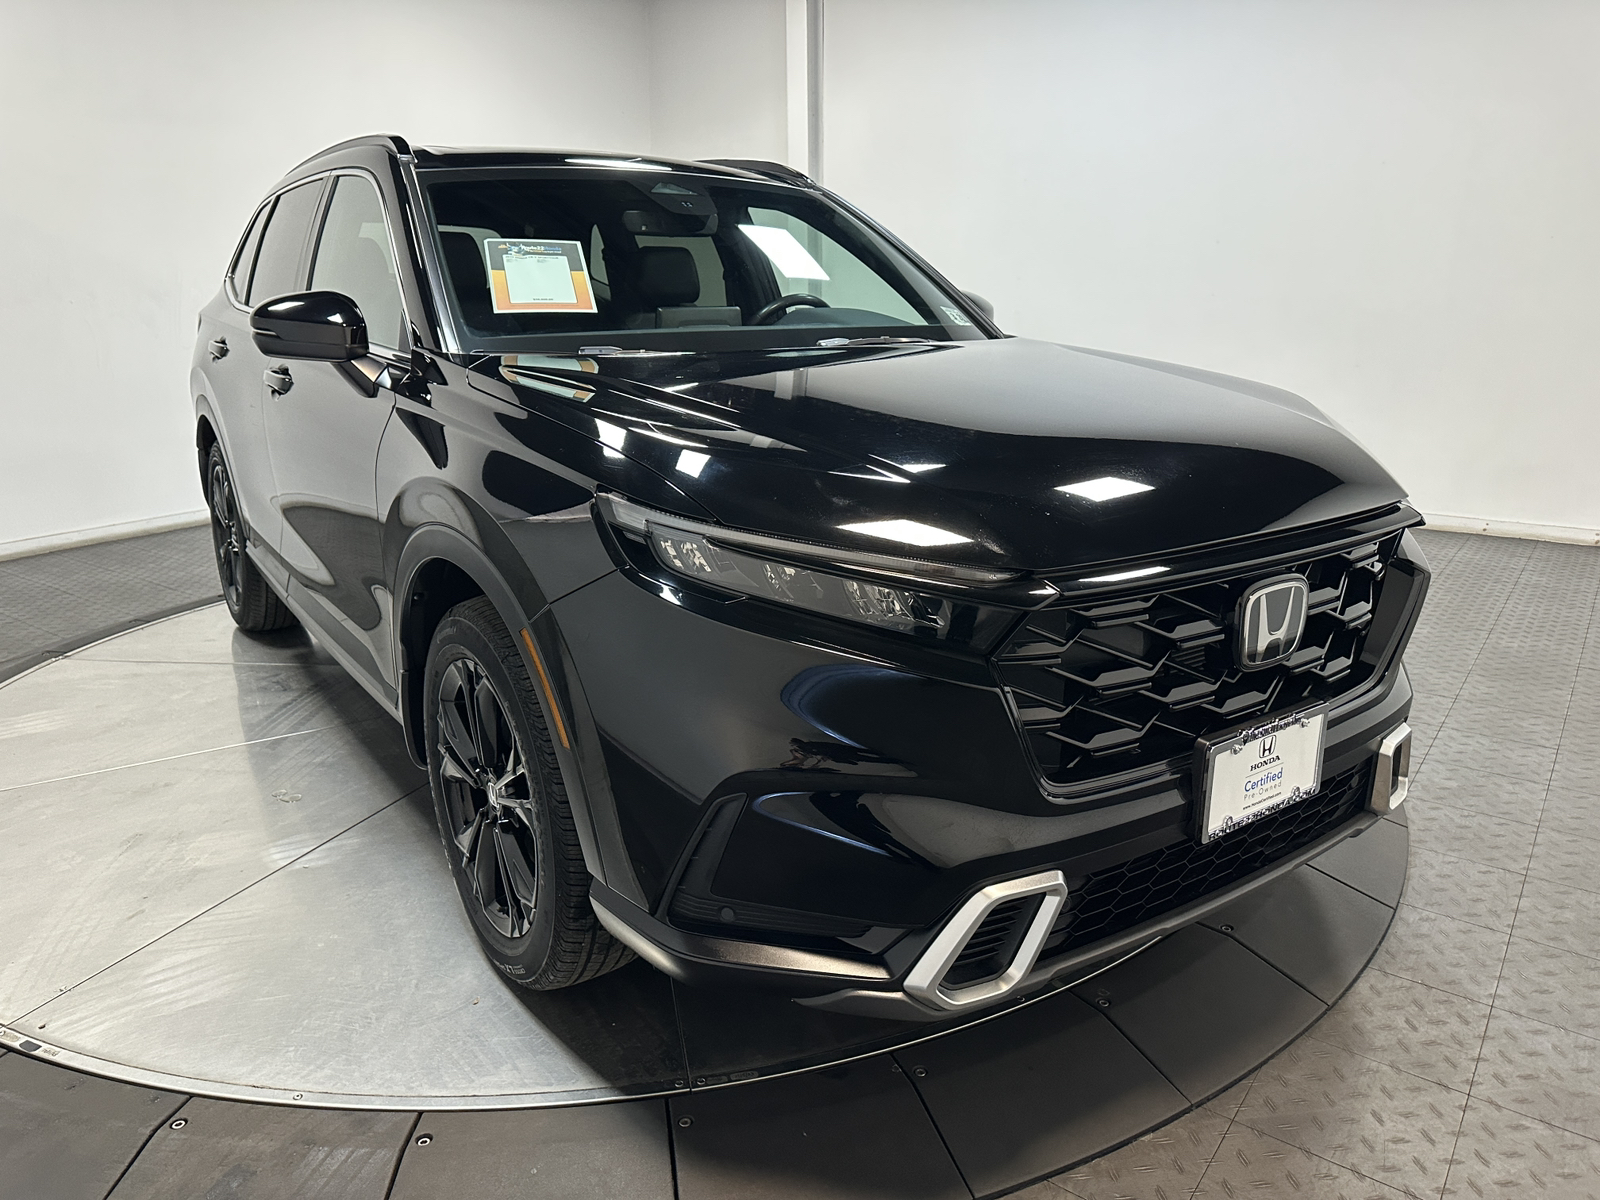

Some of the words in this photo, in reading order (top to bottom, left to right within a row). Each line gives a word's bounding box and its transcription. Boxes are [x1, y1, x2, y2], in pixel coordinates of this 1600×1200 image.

[1249, 755, 1281, 772] HONDA
[1244, 767, 1283, 792] Certified
[1243, 781, 1282, 800] Pre-Owned
